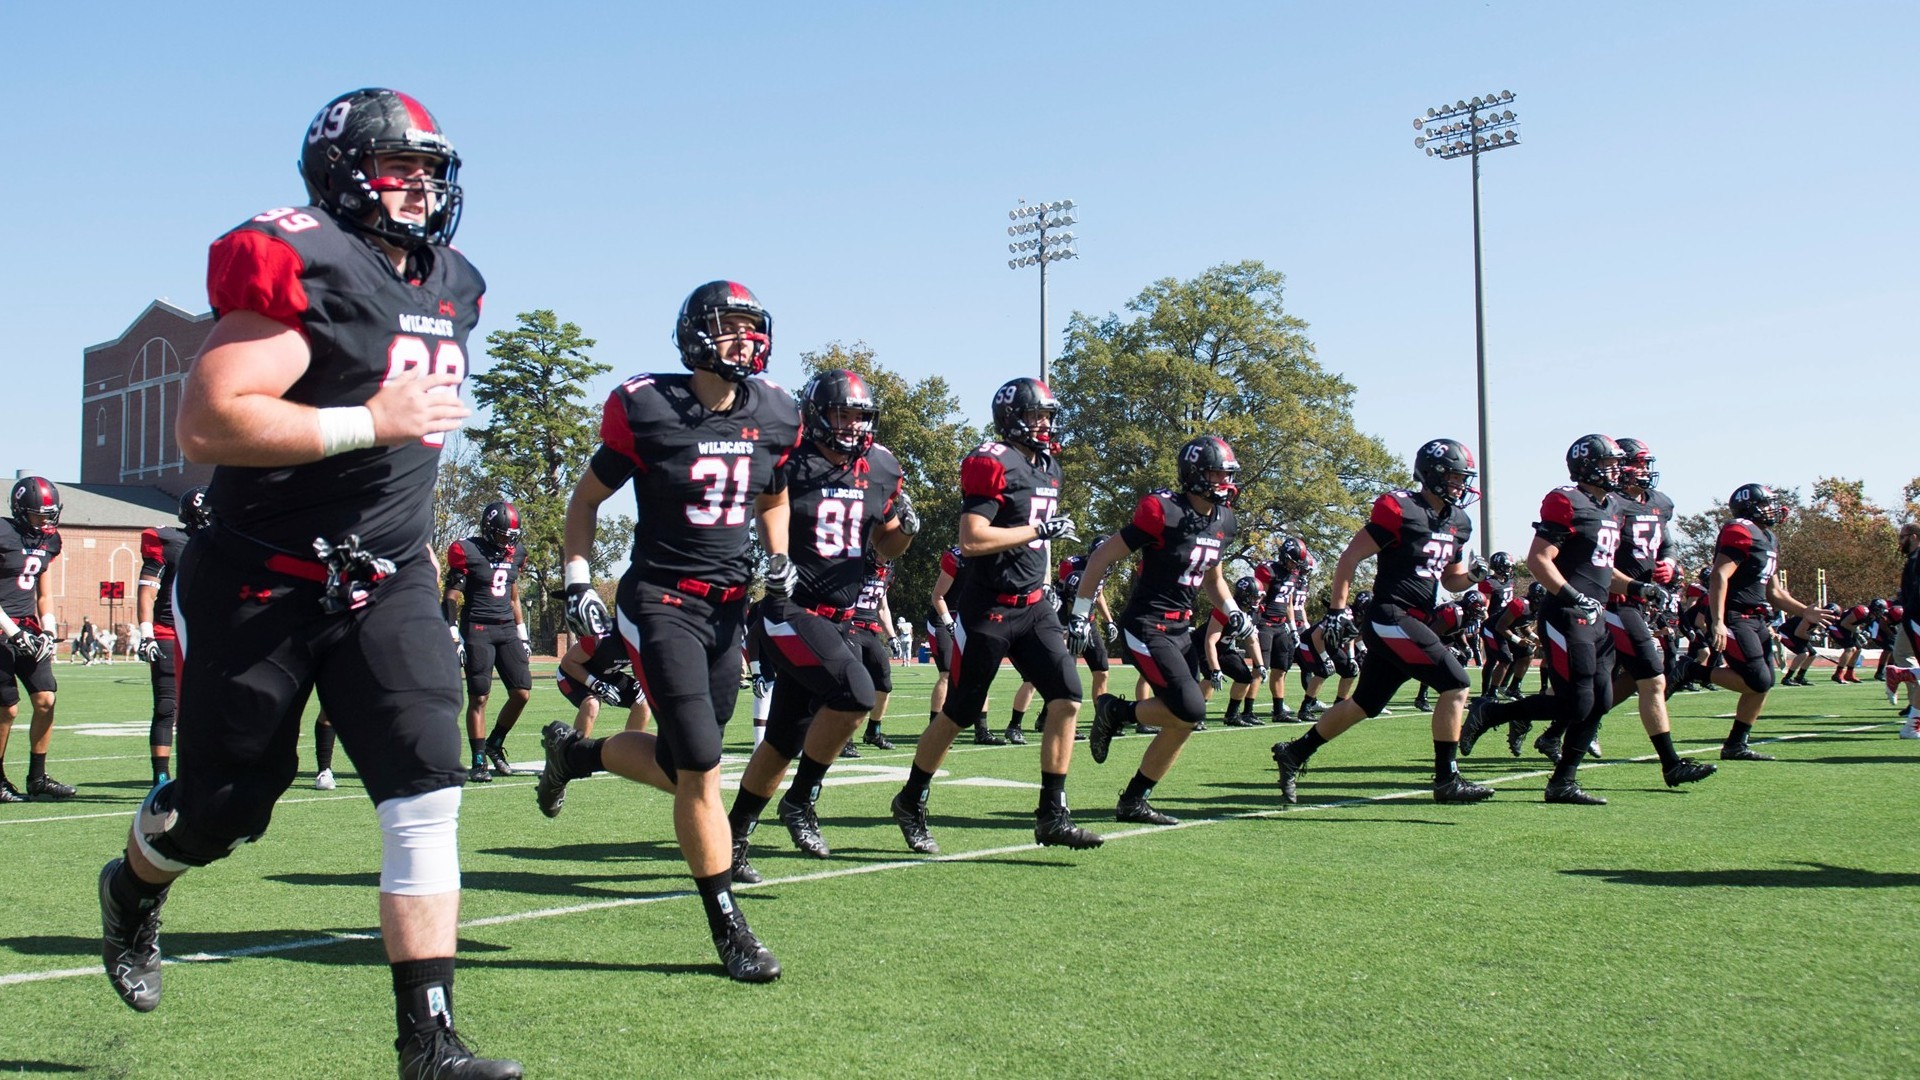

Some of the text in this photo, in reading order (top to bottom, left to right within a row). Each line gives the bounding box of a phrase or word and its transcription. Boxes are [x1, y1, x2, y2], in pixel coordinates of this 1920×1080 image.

[308, 101, 352, 144] 99
[252, 207, 320, 234] 99
[399, 313, 454, 338] WILDCATS
[996, 386, 1017, 404] 59
[698, 441, 754, 454] WILDCATS
[979, 441, 1006, 456] 59
[1184, 445, 1203, 462] 15
[1427, 441, 1449, 458] 36
[1571, 442, 1590, 459] 85
[193, 492, 205, 507] 5
[685, 456, 750, 526] 31
[821, 488, 864, 499] WILDCATS
[1735, 489, 1750, 501] 40
[816, 499, 864, 557] 81
[1591, 528, 1620, 568] 85
[1632, 522, 1661, 560] 54
[1178, 545, 1219, 587] 15
[100, 582, 124, 599] 22
[491, 569, 508, 597] 9
